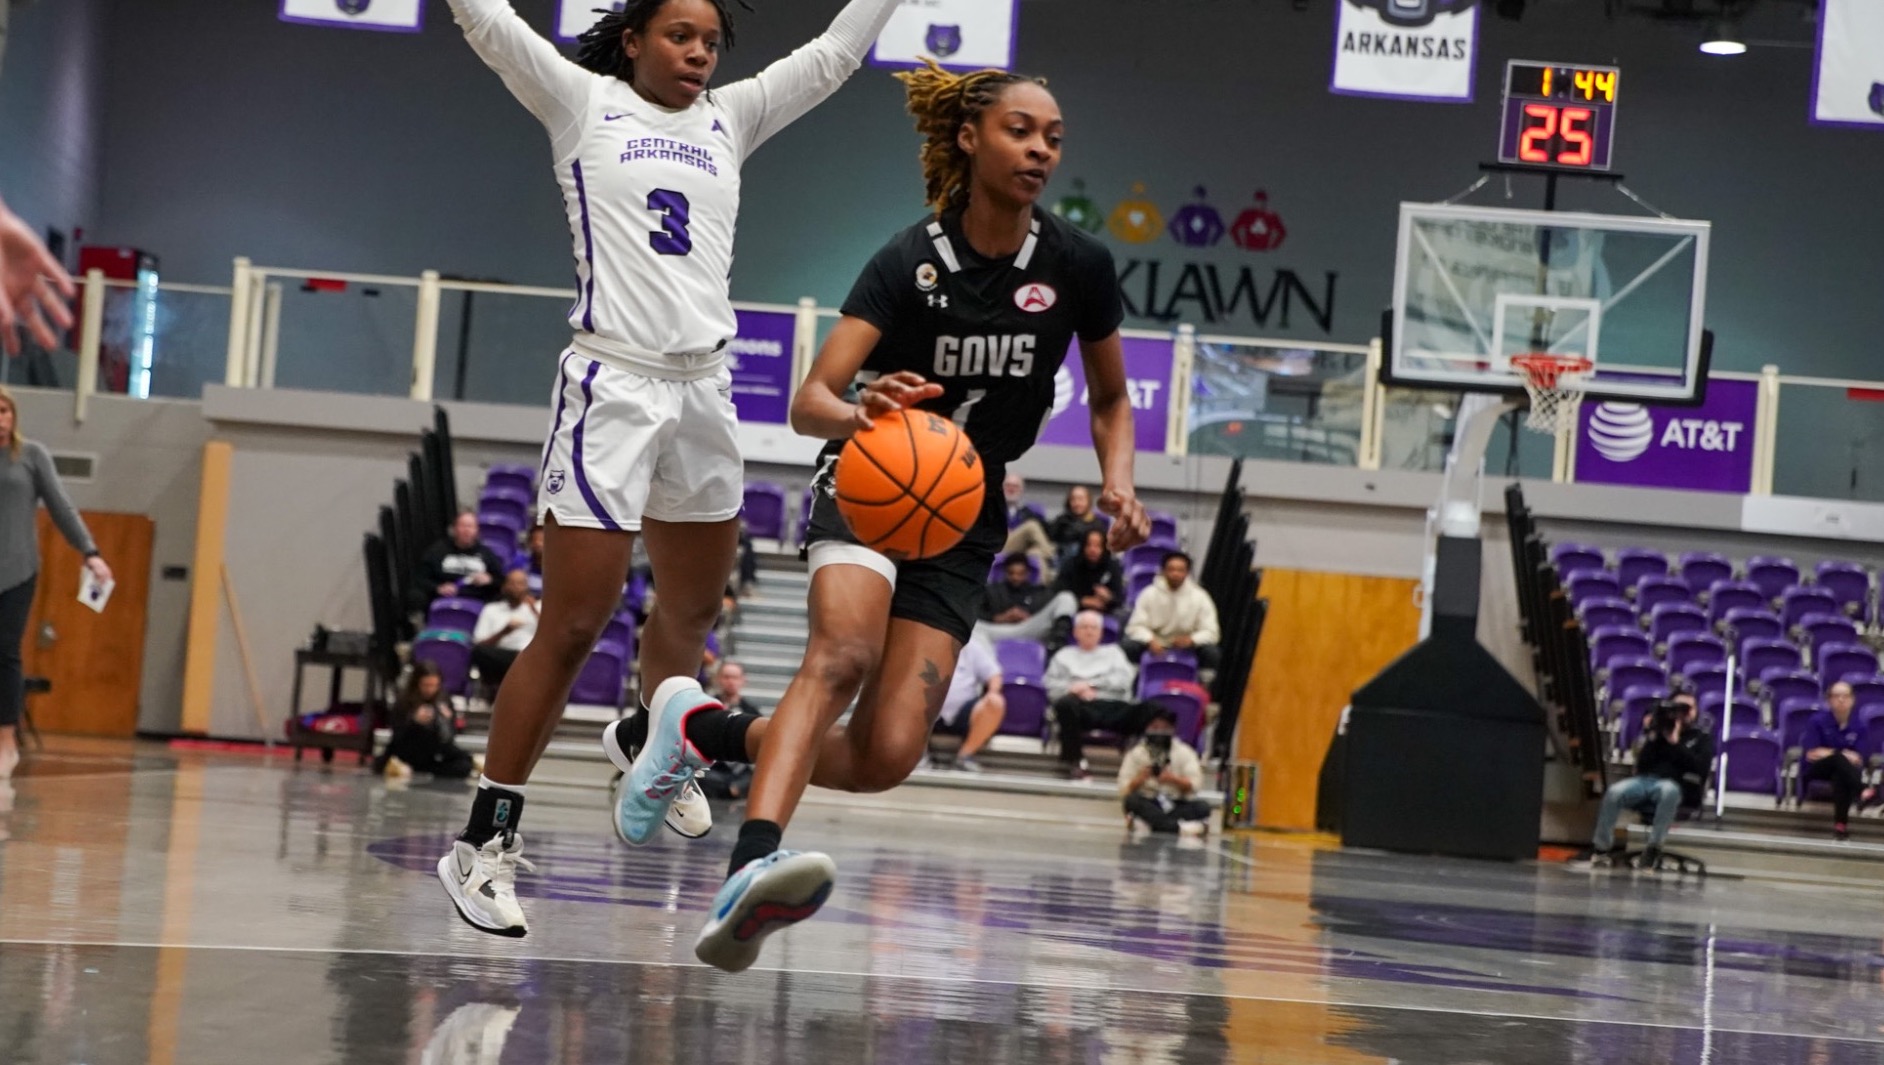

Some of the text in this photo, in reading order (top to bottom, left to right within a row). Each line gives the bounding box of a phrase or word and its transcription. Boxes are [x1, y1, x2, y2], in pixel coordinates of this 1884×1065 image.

[1342, 31, 1467, 60] ARKANSAS
[626, 138, 713, 162] CENTRAL
[1519, 104, 1593, 166] 25
[620, 149, 718, 177] ARKANSAS
[646, 188, 692, 256] 3
[933, 334, 1036, 377] GOVS
[1660, 418, 1743, 452] AT&T
